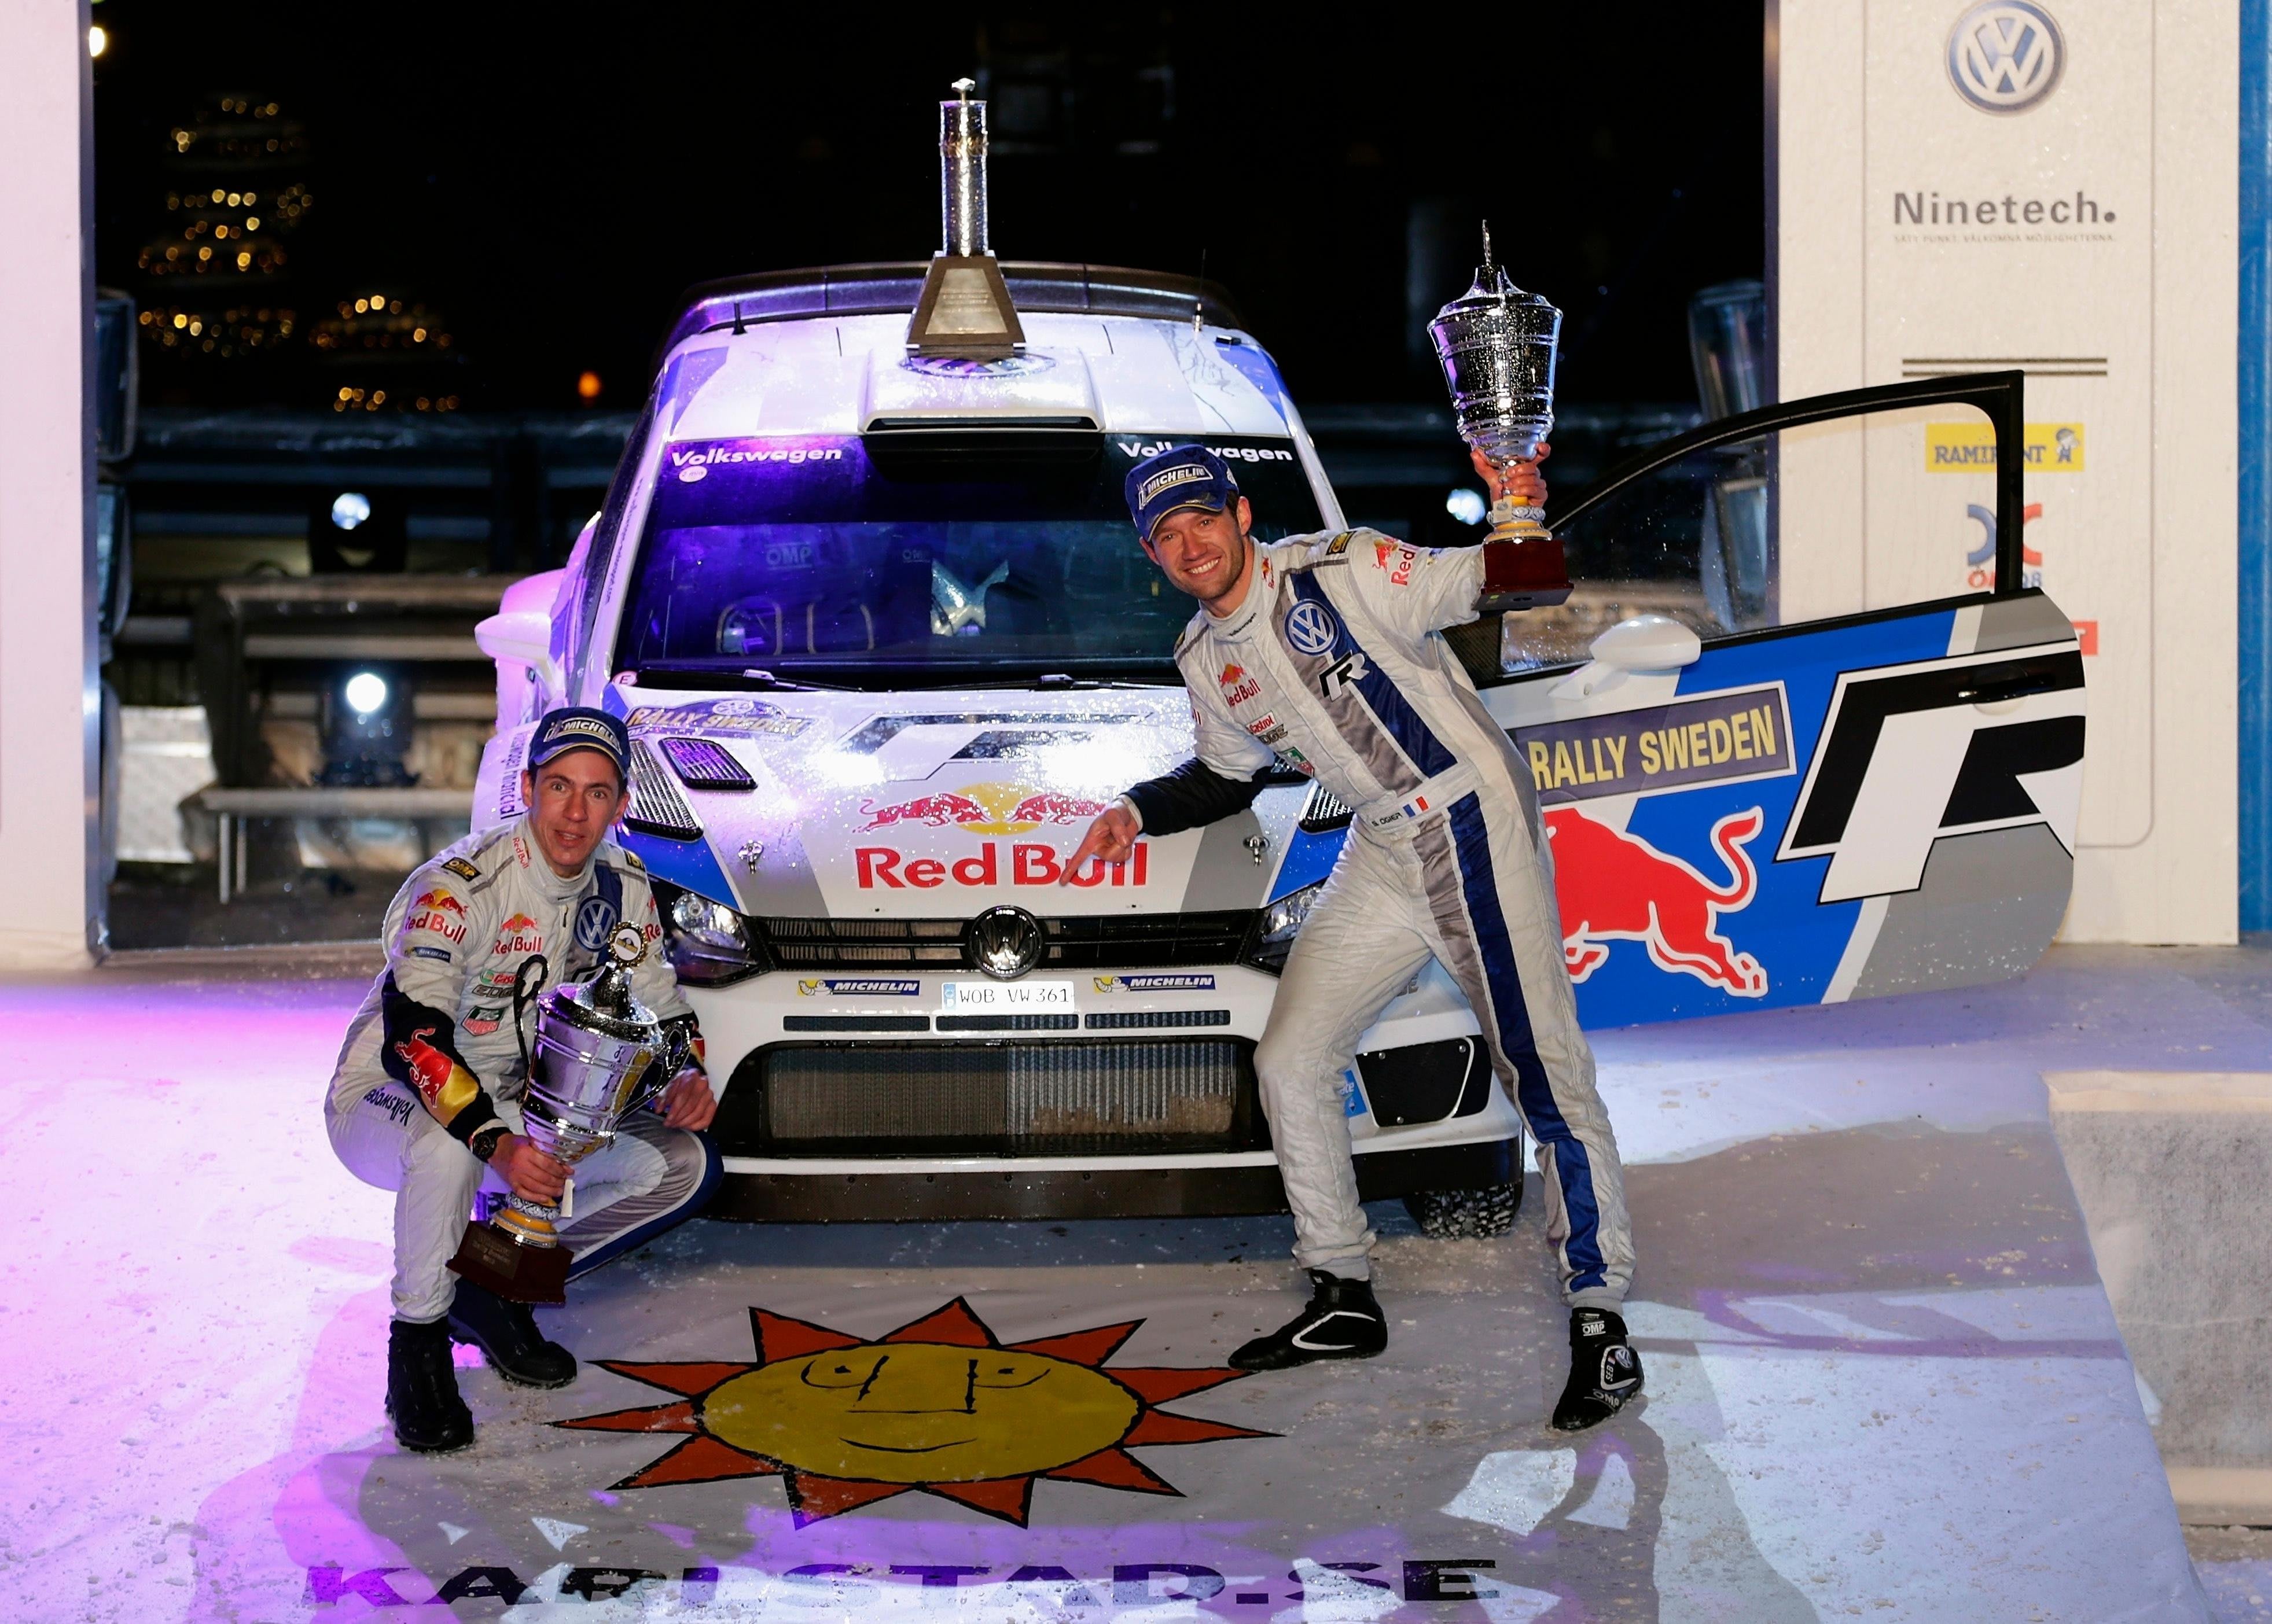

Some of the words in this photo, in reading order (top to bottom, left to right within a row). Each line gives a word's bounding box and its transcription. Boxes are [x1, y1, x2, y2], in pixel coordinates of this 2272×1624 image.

[1894, 191, 2116, 225] Ninetech.
[671, 448, 842, 466] Volkswagen
[1117, 441, 1293, 462] Volwagen
[1935, 444, 2046, 463] RAMINT
[1146, 466, 1206, 494] MICHELIN
[627, 708, 708, 728] RALLY
[1258, 723, 1289, 745] DGE
[1528, 735, 1627, 791] RALLY
[1639, 704, 1777, 775] SWEDEN
[1379, 812, 1403, 824] OGIER
[448, 860, 475, 876] OMP
[854, 842, 997, 889] Red
[1013, 842, 1148, 888] Bull
[429, 914, 467, 945] Bull
[645, 923, 661, 941] Re
[513, 936, 542, 953] Bull
[834, 982, 918, 991] MICHELIN
[1130, 977, 1213, 987] MICHELIN
[472, 984, 514, 999] EDG
[959, 989, 995, 1003] WOB
[1008, 988, 1030, 1003] VW
[1035, 988, 1069, 1003] 361
[1582, 1323, 1605, 1334] OMP
[1605, 1365, 1614, 1382] SEB
[1593, 1390, 1620, 1408] OMP
